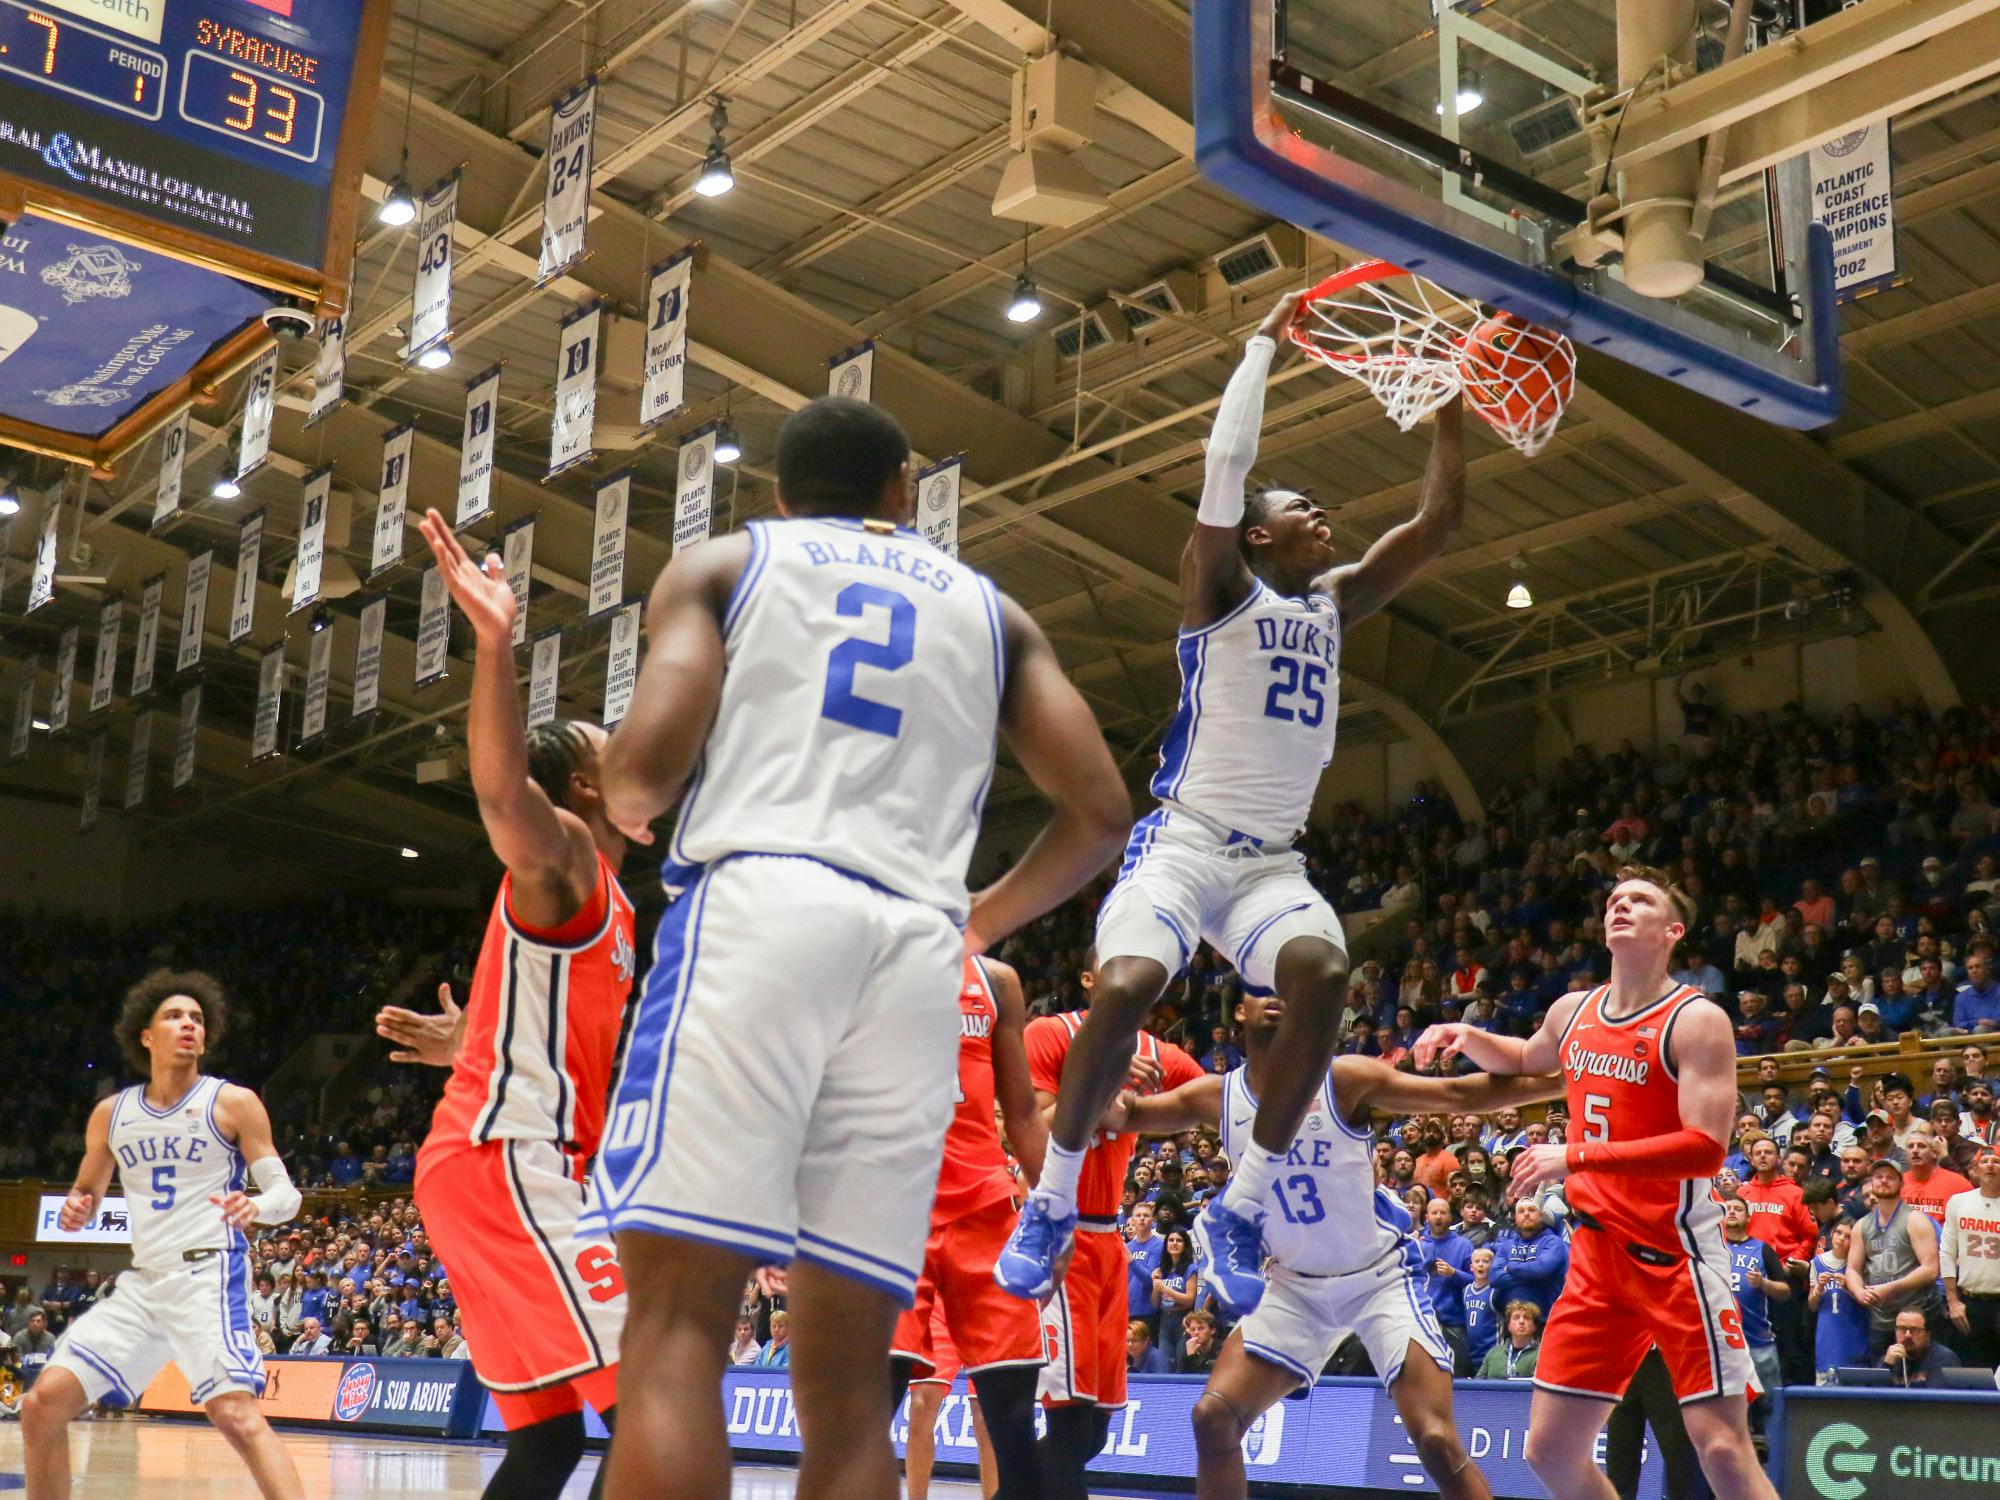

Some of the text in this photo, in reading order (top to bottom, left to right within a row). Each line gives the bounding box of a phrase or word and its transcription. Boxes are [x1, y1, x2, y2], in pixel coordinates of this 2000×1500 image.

[109, 48, 162, 79] PERIOD
[196, 18, 320, 84] SYRACUSE
[134, 75, 145, 102] 1
[225, 71, 297, 145] 33
[551, 111, 591, 156] DAWKINS
[551, 143, 585, 198] 24
[1815, 161, 1875, 196] ATLANTIC
[1822, 192, 1889, 227] NFERENCE
[1824, 182, 1867, 209] COAST
[1829, 212, 1887, 243] AMPIONS
[420, 232, 449, 277] 43
[1834, 238, 1874, 258] URNAMENT
[77, 323, 169, 386] Washington Duke
[112, 374, 144, 386] Inn
[136, 343, 173, 367] Golf
[660, 353, 682, 373] FOUR
[653, 391, 669, 409] 1986
[164, 427, 182, 463] 10
[681, 484, 706, 506] ATLANTIC
[683, 498, 702, 516] COAST
[674, 507, 710, 532] CONFERENCE
[674, 520, 707, 544] CHAMPIONS
[598, 528, 622, 546] ATLANTIC
[600, 541, 617, 557] COAST
[592, 550, 624, 573] CONFERENCE
[592, 562, 622, 583] CHAMPIONS
[800, 541, 955, 594] BLAKES
[1254, 616, 1337, 670] DUKE
[821, 582, 917, 740] 2
[1264, 655, 1327, 729] 25
[1565, 1040, 1650, 1087] Syracuse
[1584, 1093, 1612, 1143] 5
[118, 1136, 208, 1170] DUKE
[151, 1166, 178, 1212] 5
[1271, 1173, 1326, 1226] 13
[1904, 1196, 1945, 1207] RACUSE
[1748, 1200, 1785, 1216] yracuse
[1735, 1253, 1760, 1272] KE
[1967, 1234, 2000, 1260] 23
[1464, 1300, 1486, 1311] DUKE
[1468, 1310, 1478, 1327] 0
[1831, 1292, 1839, 1314] 1
[370, 1380, 457, 1413] A SUB ABOVE
[727, 1386, 801, 1438] DUK
